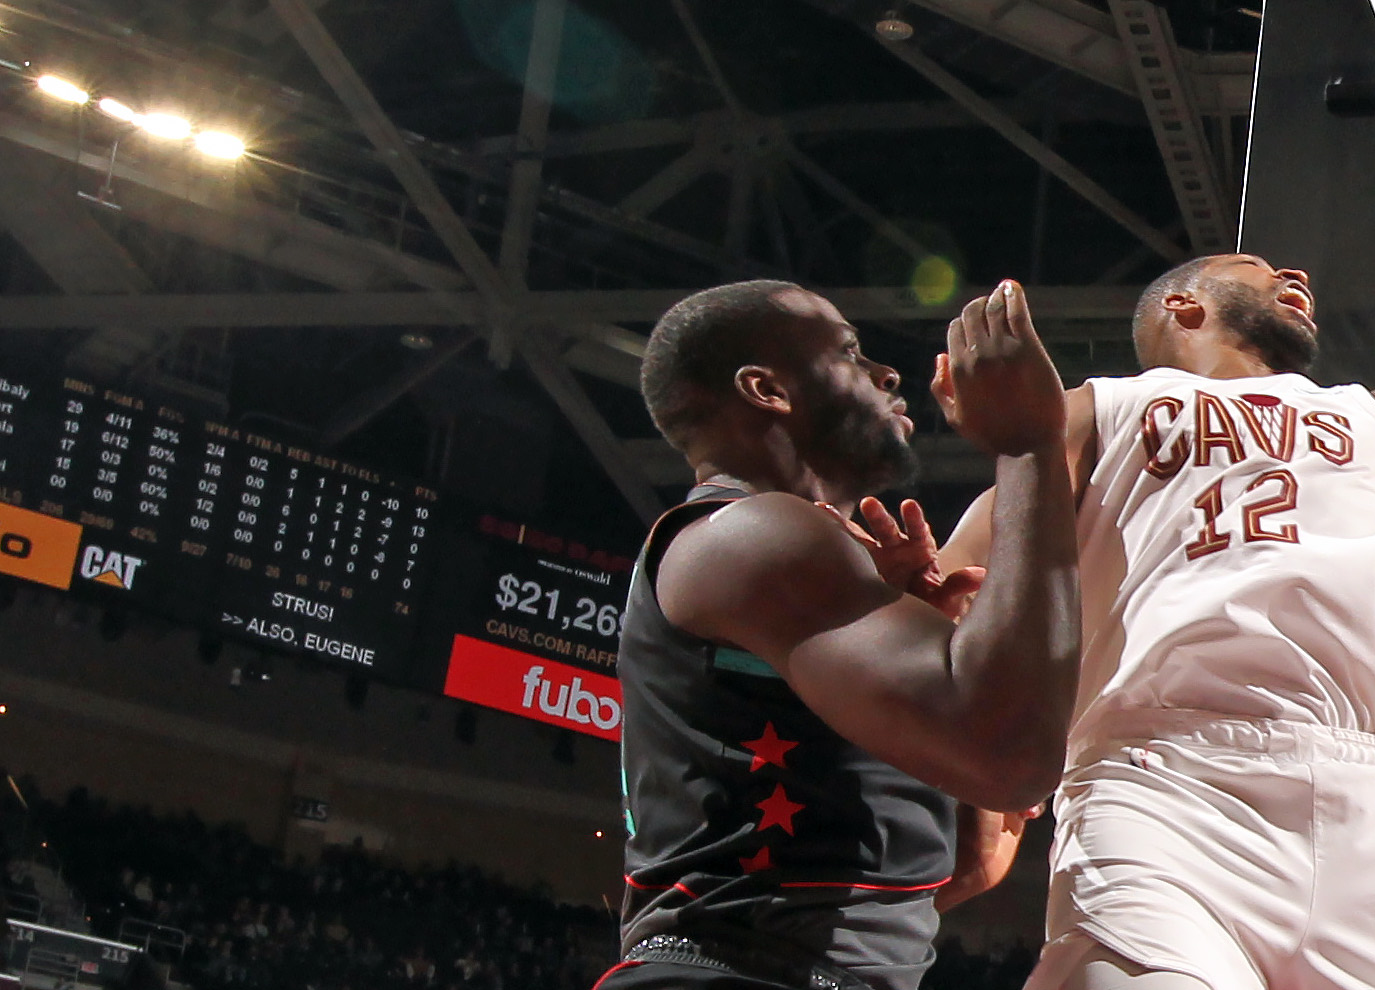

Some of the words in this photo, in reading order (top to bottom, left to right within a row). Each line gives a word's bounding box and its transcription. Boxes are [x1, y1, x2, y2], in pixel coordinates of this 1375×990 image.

[67, 400, 84, 414] 29
[105, 412, 133, 431] 4/11
[152, 426, 180, 445] 36%
[206, 442, 226, 459] 2/4
[249, 456, 269, 472] 0/2
[289, 468, 299, 480] 5
[319, 477, 326, 489] 1
[340, 484, 348, 496] 1
[361, 490, 370, 502] 0
[381, 499, 400, 511] -10
[415, 506, 429, 520] 10
[1142, 389, 1354, 481] CAVS
[60, 439, 75, 452] 17
[147, 464, 168, 480] 0%
[197, 479, 218, 496] 0/2
[241, 491, 261, 508] 0/0
[281, 504, 290, 517] 6
[309, 513, 318, 525] 0
[333, 520, 340, 532] 1
[353, 527, 363, 538] 2
[410, 542, 418, 555] 0
[101, 431, 130, 450] 6/12
[203, 462, 222, 477] 1/6
[245, 474, 265, 490] 0/0
[287, 487, 294, 499] 1
[314, 496, 321, 507] 1
[335, 502, 344, 514] 2
[357, 509, 366, 521] 2
[411, 525, 426, 538] 13
[140, 482, 168, 500] 60%
[196, 498, 214, 513] 1/2
[237, 510, 257, 525] 0/0
[278, 522, 287, 535] 2
[307, 531, 314, 542] 1
[329, 537, 337, 549] 1
[350, 544, 359, 555] 0
[407, 560, 415, 572] 7
[1185, 469, 1300, 562] 12
[49, 474, 67, 489] 00
[92, 486, 113, 502] 0/0
[140, 500, 160, 517] 0%
[189, 515, 210, 531] 0/0
[233, 528, 253, 543] 0/0
[274, 540, 283, 553] 0
[301, 548, 311, 560] 0
[324, 555, 333, 567] 0
[346, 561, 355, 573] 0
[371, 569, 380, 581] 0
[402, 578, 411, 589] 0
[80, 545, 143, 590] CAT
[245, 617, 298, 648] ALSO,
[303, 633, 377, 667] EUGENE
[485, 618, 619, 667] CAVS.COM/RAFF
[495, 572, 626, 638] $21,26
[522, 665, 622, 731] fubo
